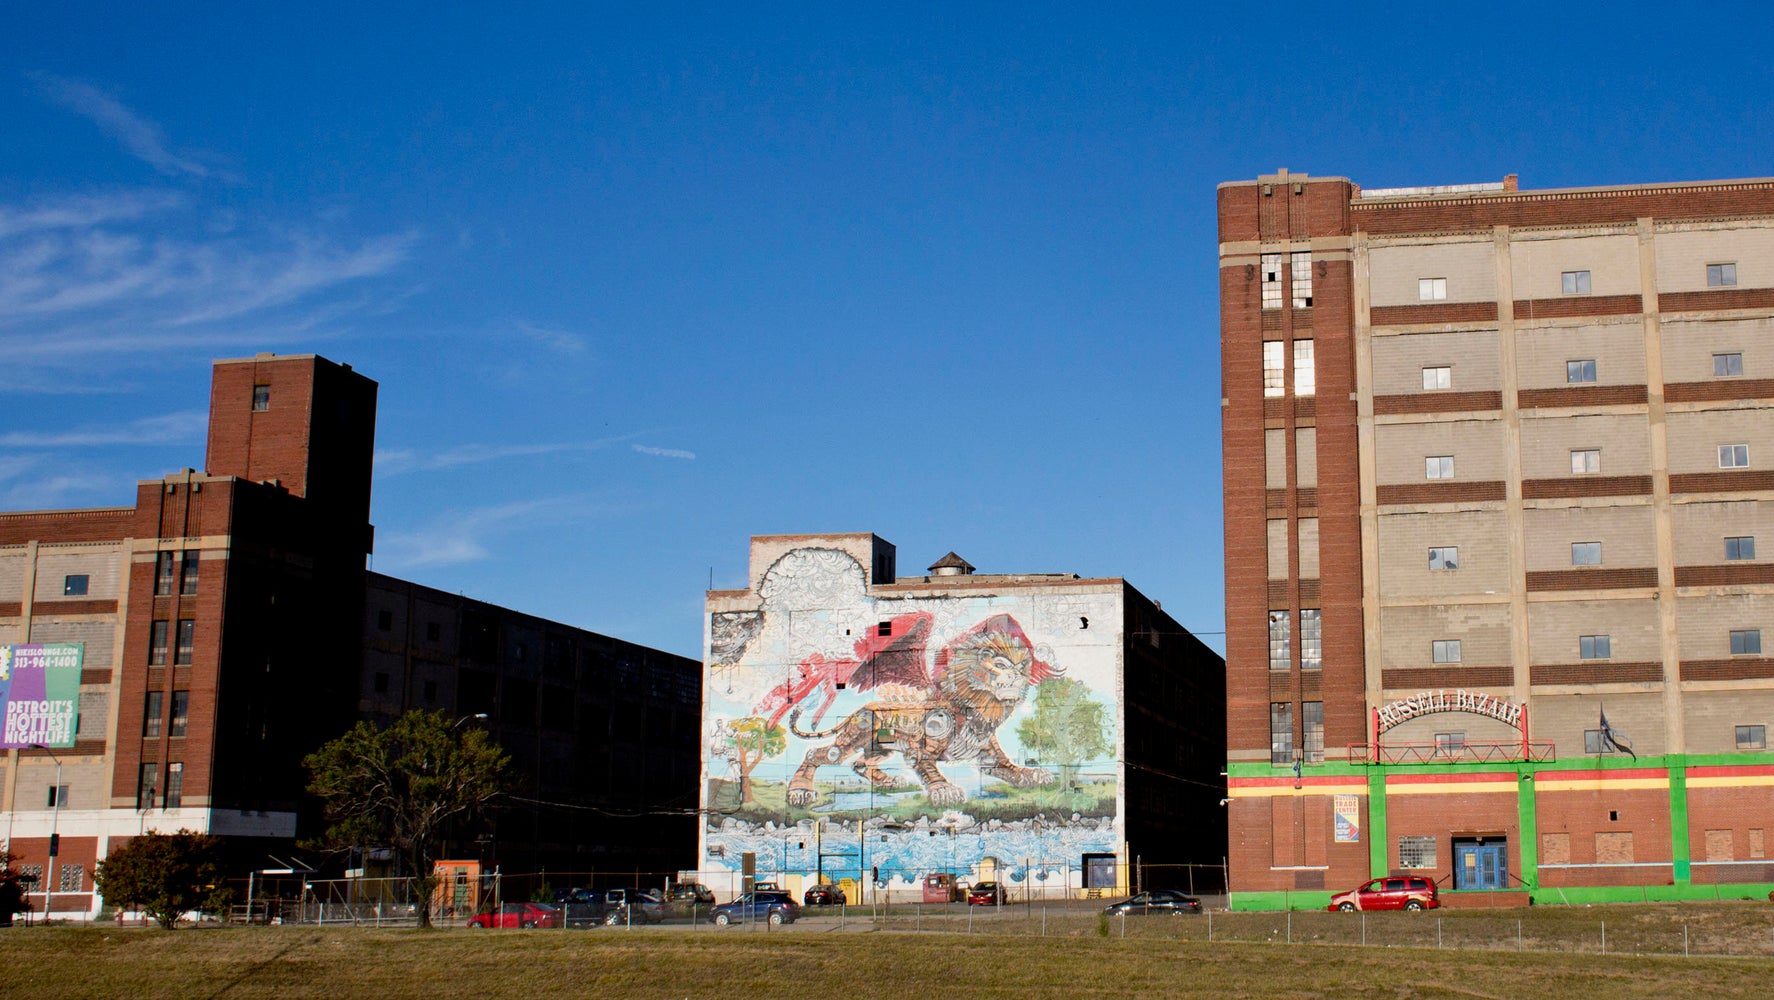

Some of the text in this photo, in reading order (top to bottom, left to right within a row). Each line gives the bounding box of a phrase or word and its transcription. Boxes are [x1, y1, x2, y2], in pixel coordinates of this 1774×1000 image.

[7, 700, 73, 713] DETROIT'S
[1377, 689, 1522, 727] RUSSELL BAZAAR
[6, 713, 73, 731] HOTTEST
[4, 731, 70, 743] NIGHTLIFE
